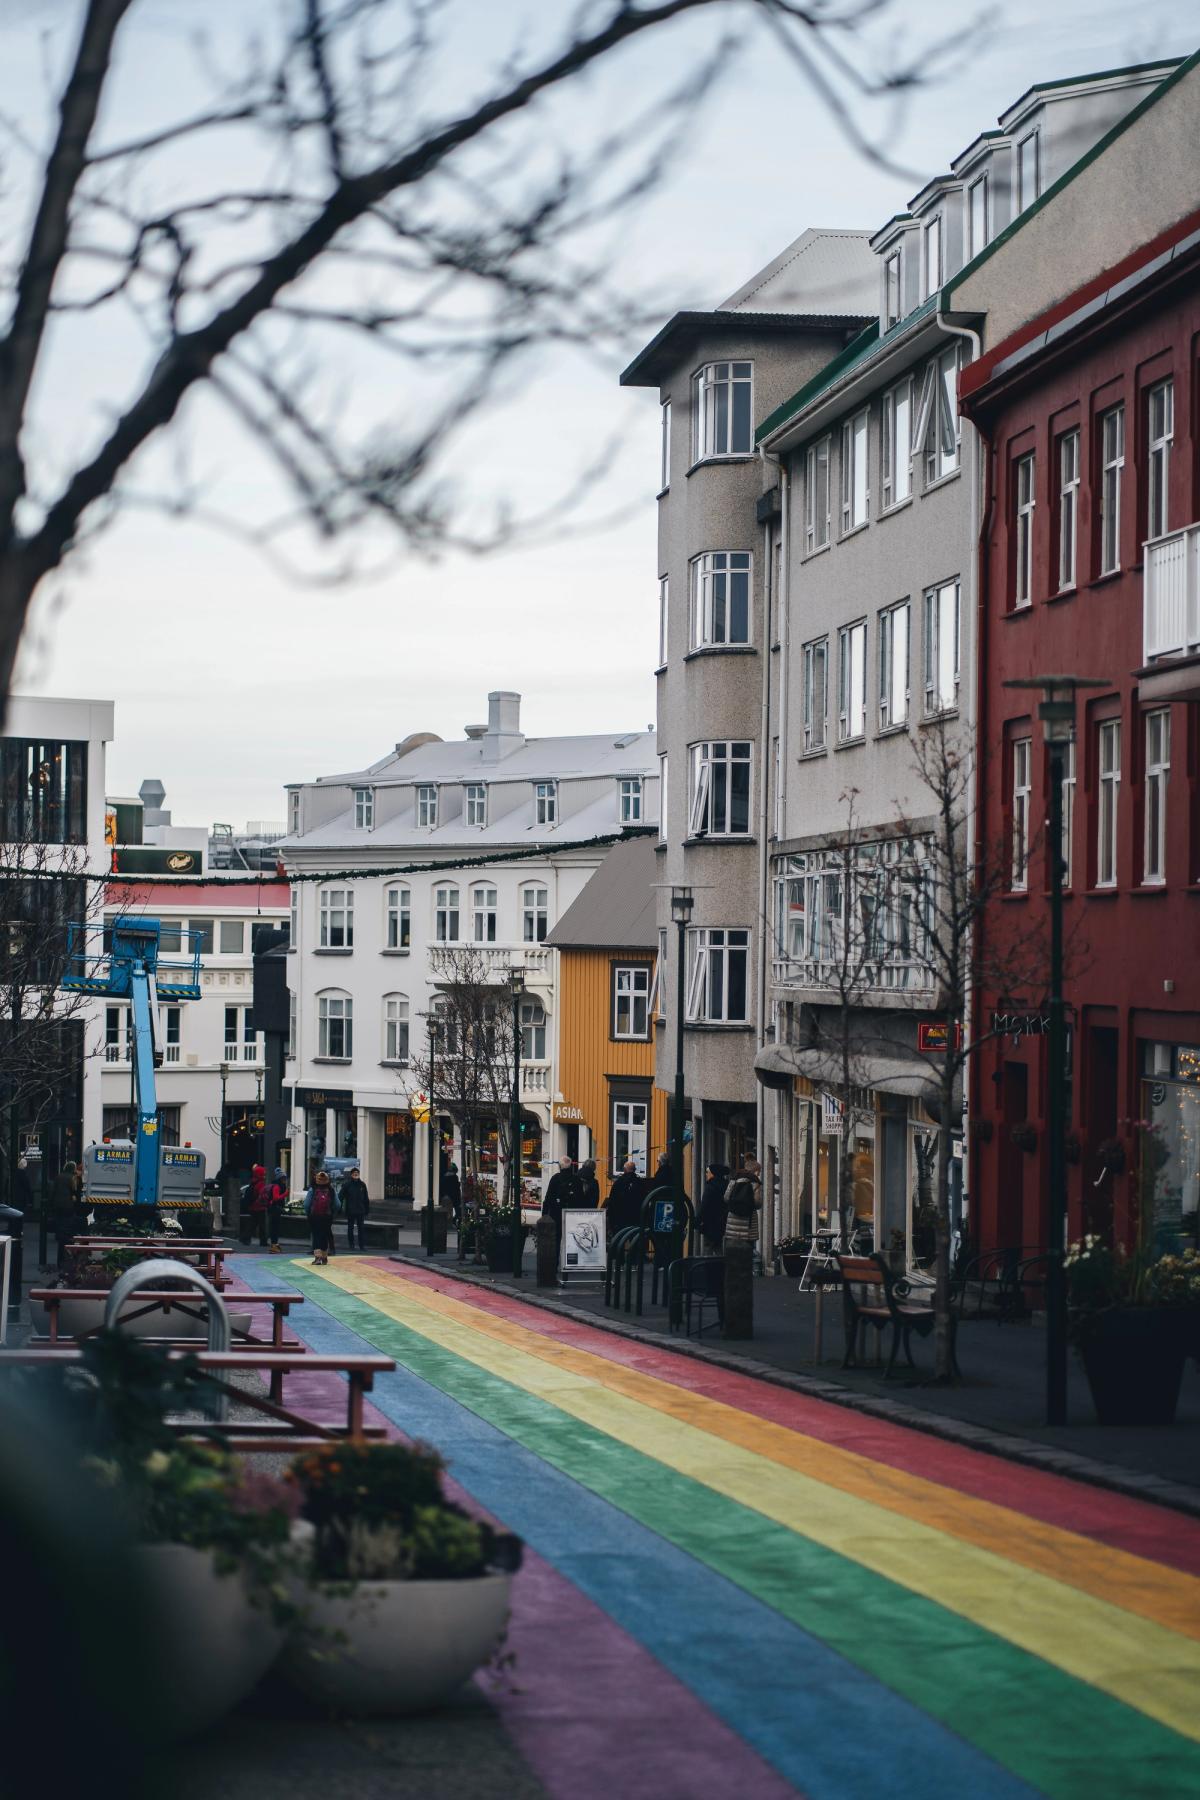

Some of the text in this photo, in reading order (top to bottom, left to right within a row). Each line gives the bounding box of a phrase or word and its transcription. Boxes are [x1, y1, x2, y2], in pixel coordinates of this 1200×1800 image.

[556, 1105, 584, 1119] ASIAN
[106, 1150, 131, 1158] ARMAR
[174, 1153, 197, 1161] ARMAR
[663, 1203, 673, 1219] P
